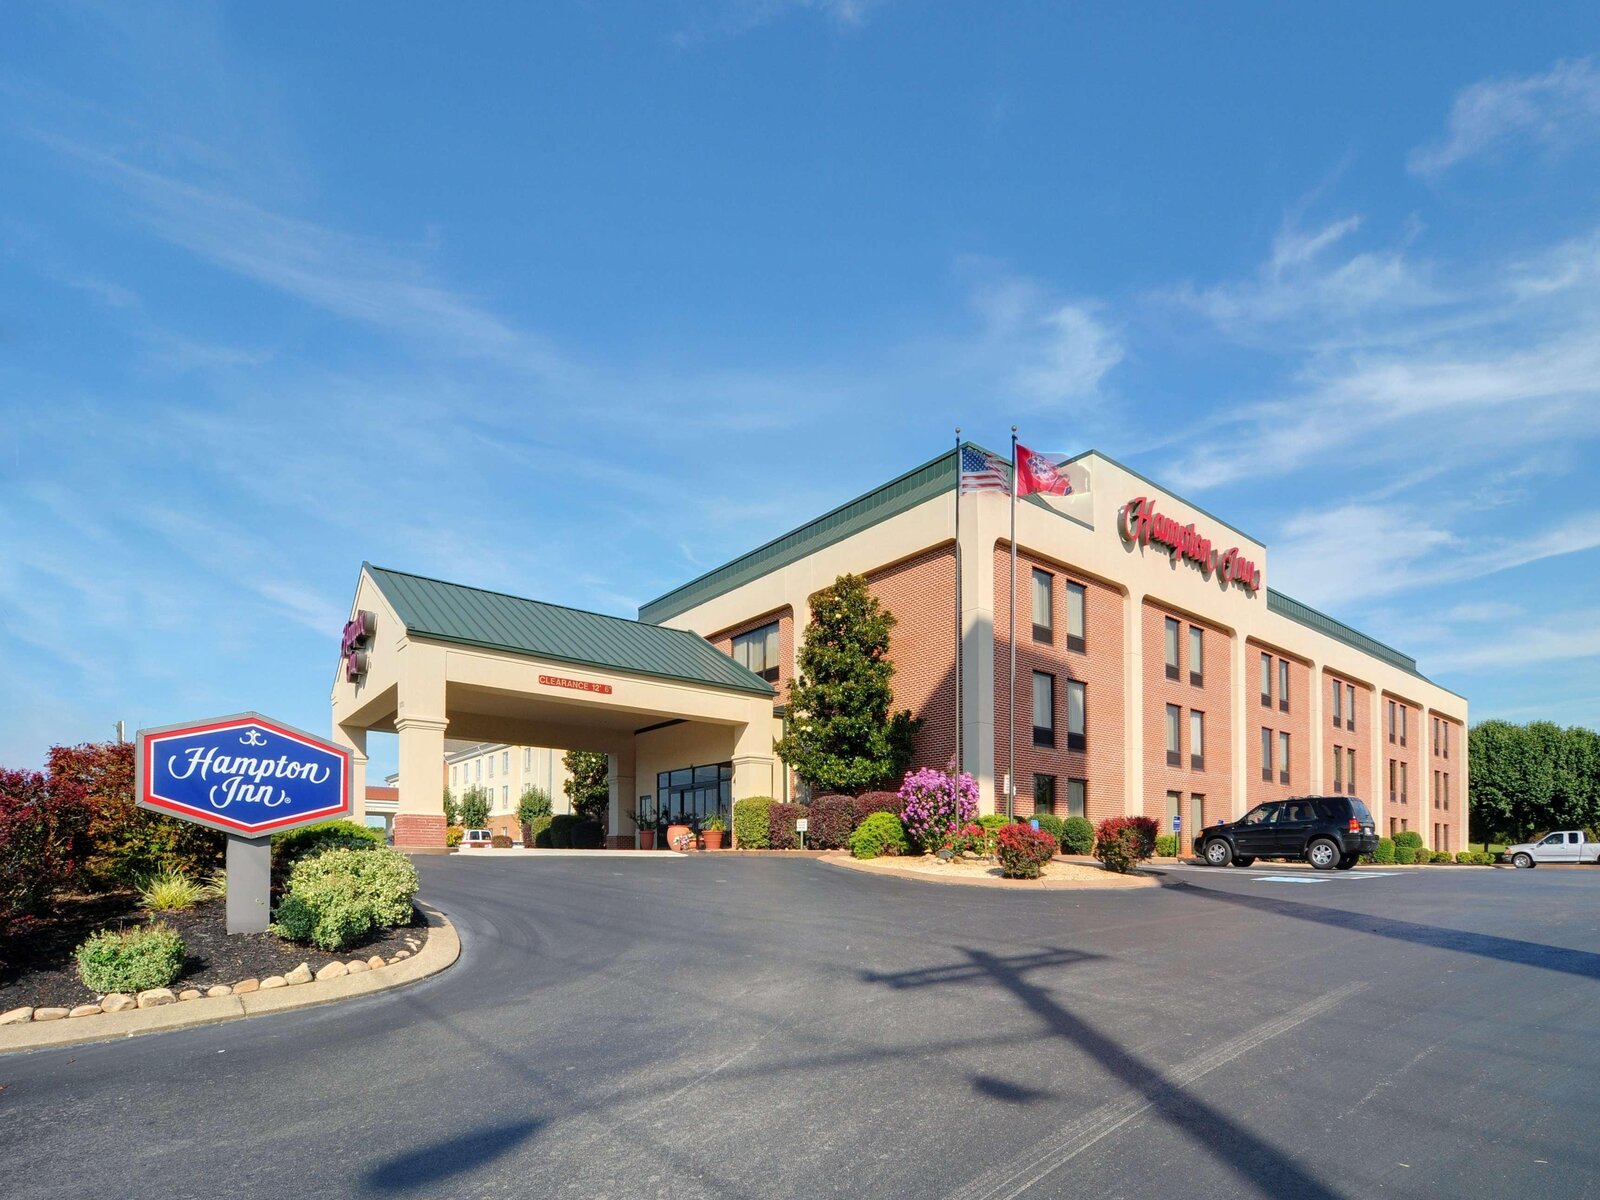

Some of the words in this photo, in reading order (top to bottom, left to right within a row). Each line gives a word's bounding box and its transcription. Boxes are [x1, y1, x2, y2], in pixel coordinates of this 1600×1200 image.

[1119, 496, 1218, 572] Hampton
[1222, 547, 1260, 591] Inn
[539, 676, 589, 690] CLEARANCE
[168, 746, 330, 784] Hampton
[209, 776, 285, 808] Inn
